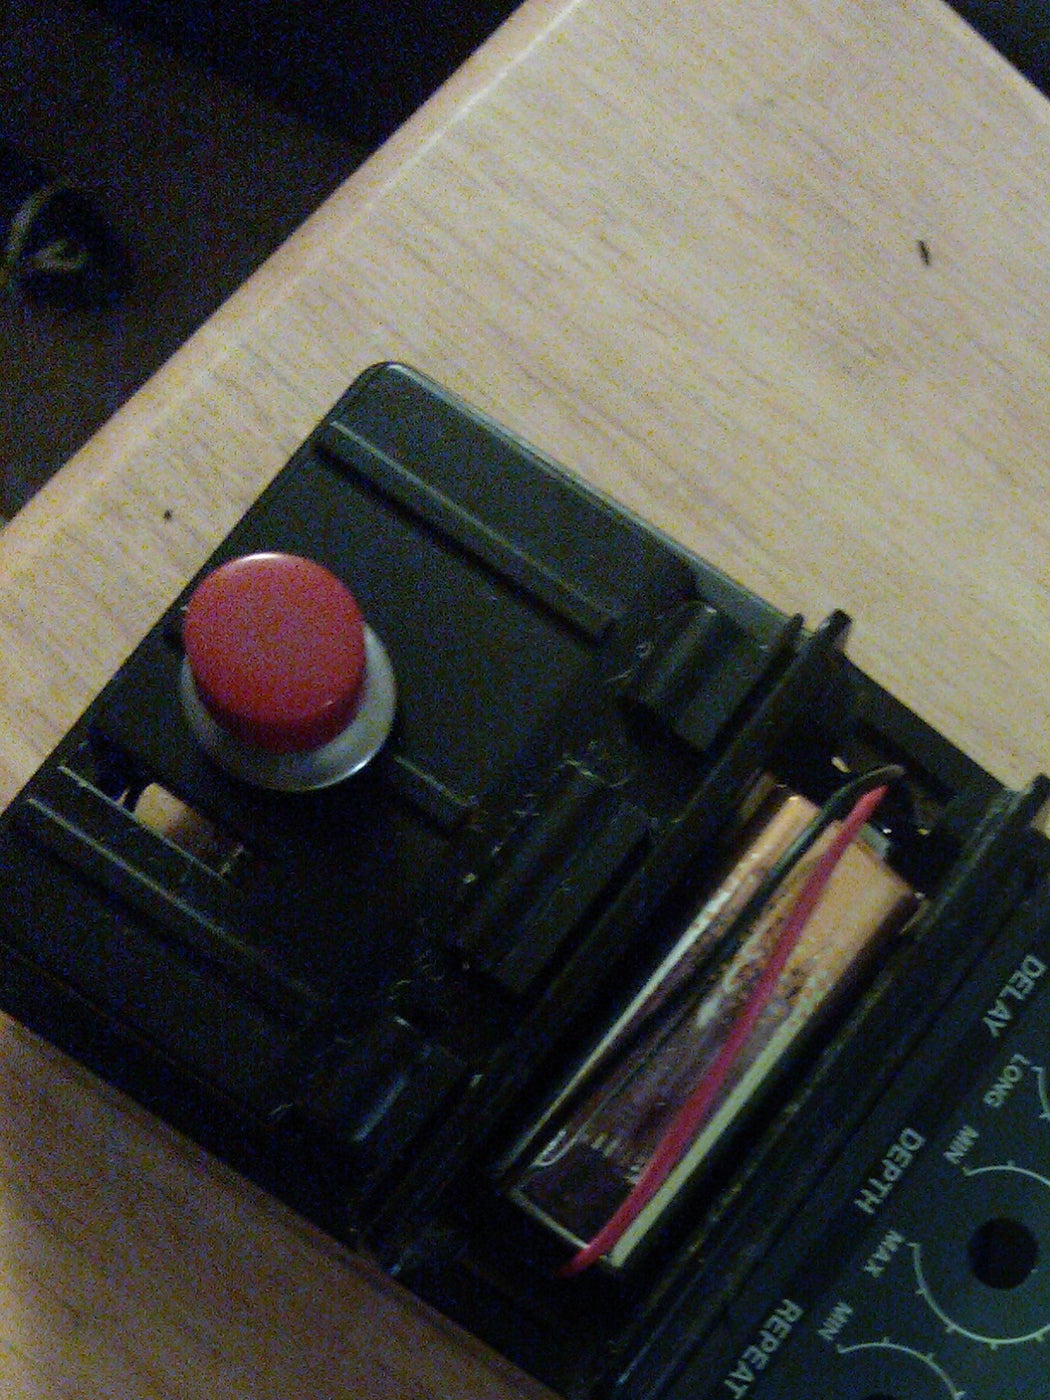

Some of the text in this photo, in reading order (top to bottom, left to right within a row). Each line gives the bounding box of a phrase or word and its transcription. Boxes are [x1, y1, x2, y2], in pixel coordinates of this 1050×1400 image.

[983, 954, 1046, 1039] DELAY
[985, 1053, 1029, 1108] LONG
[854, 1127, 927, 1214] DEPTH
[943, 1126, 979, 1165] MIN
[863, 1230, 905, 1278] MAX
[724, 1298, 803, 1398] REPEAT
[818, 1302, 854, 1342] MIN
